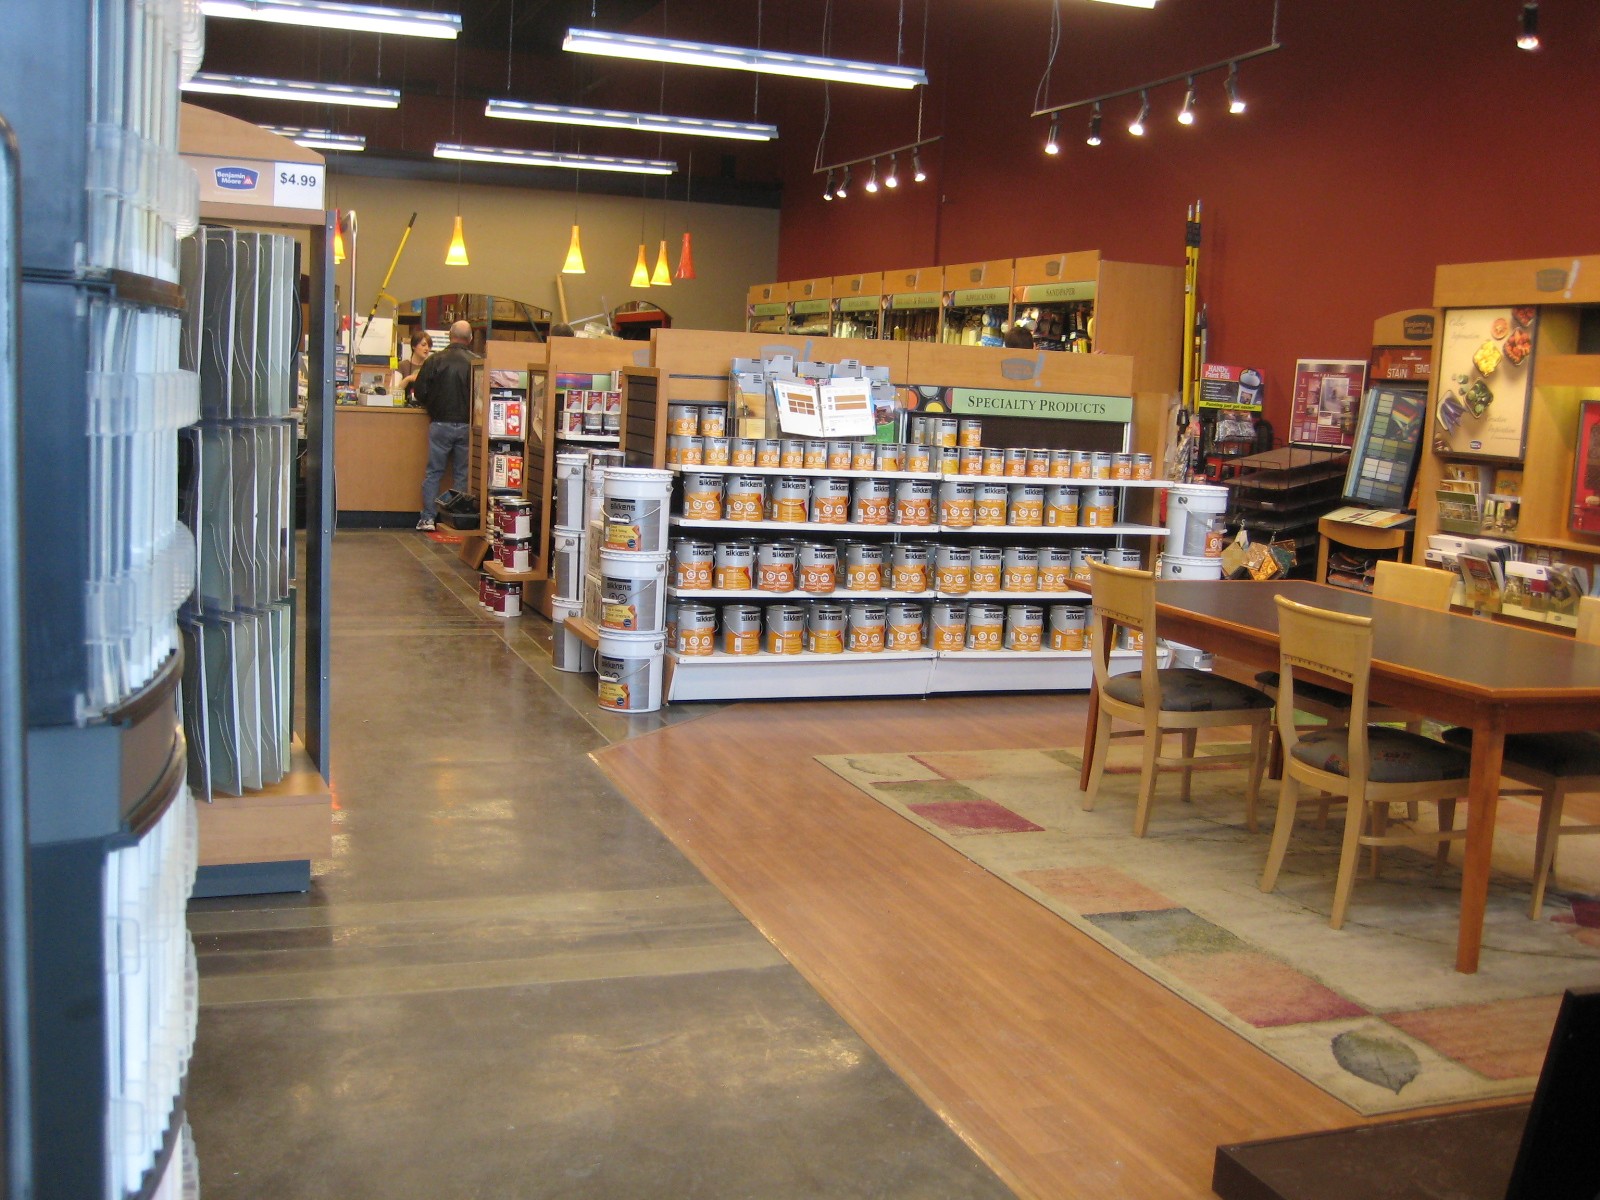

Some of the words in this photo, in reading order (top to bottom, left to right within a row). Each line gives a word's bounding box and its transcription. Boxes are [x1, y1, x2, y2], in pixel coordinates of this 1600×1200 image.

[216, 171, 246, 180] Benjamin
[280, 172, 316, 187] $4.99
[221, 177, 242, 185] Moore
[1387, 368, 1408, 379] STAIN
[967, 395, 1037, 411] SPECIALTY
[1039, 399, 1106, 414] PRODUCTS
[782, 482, 806, 490] sikkens
[607, 582, 632, 591] sikkens
